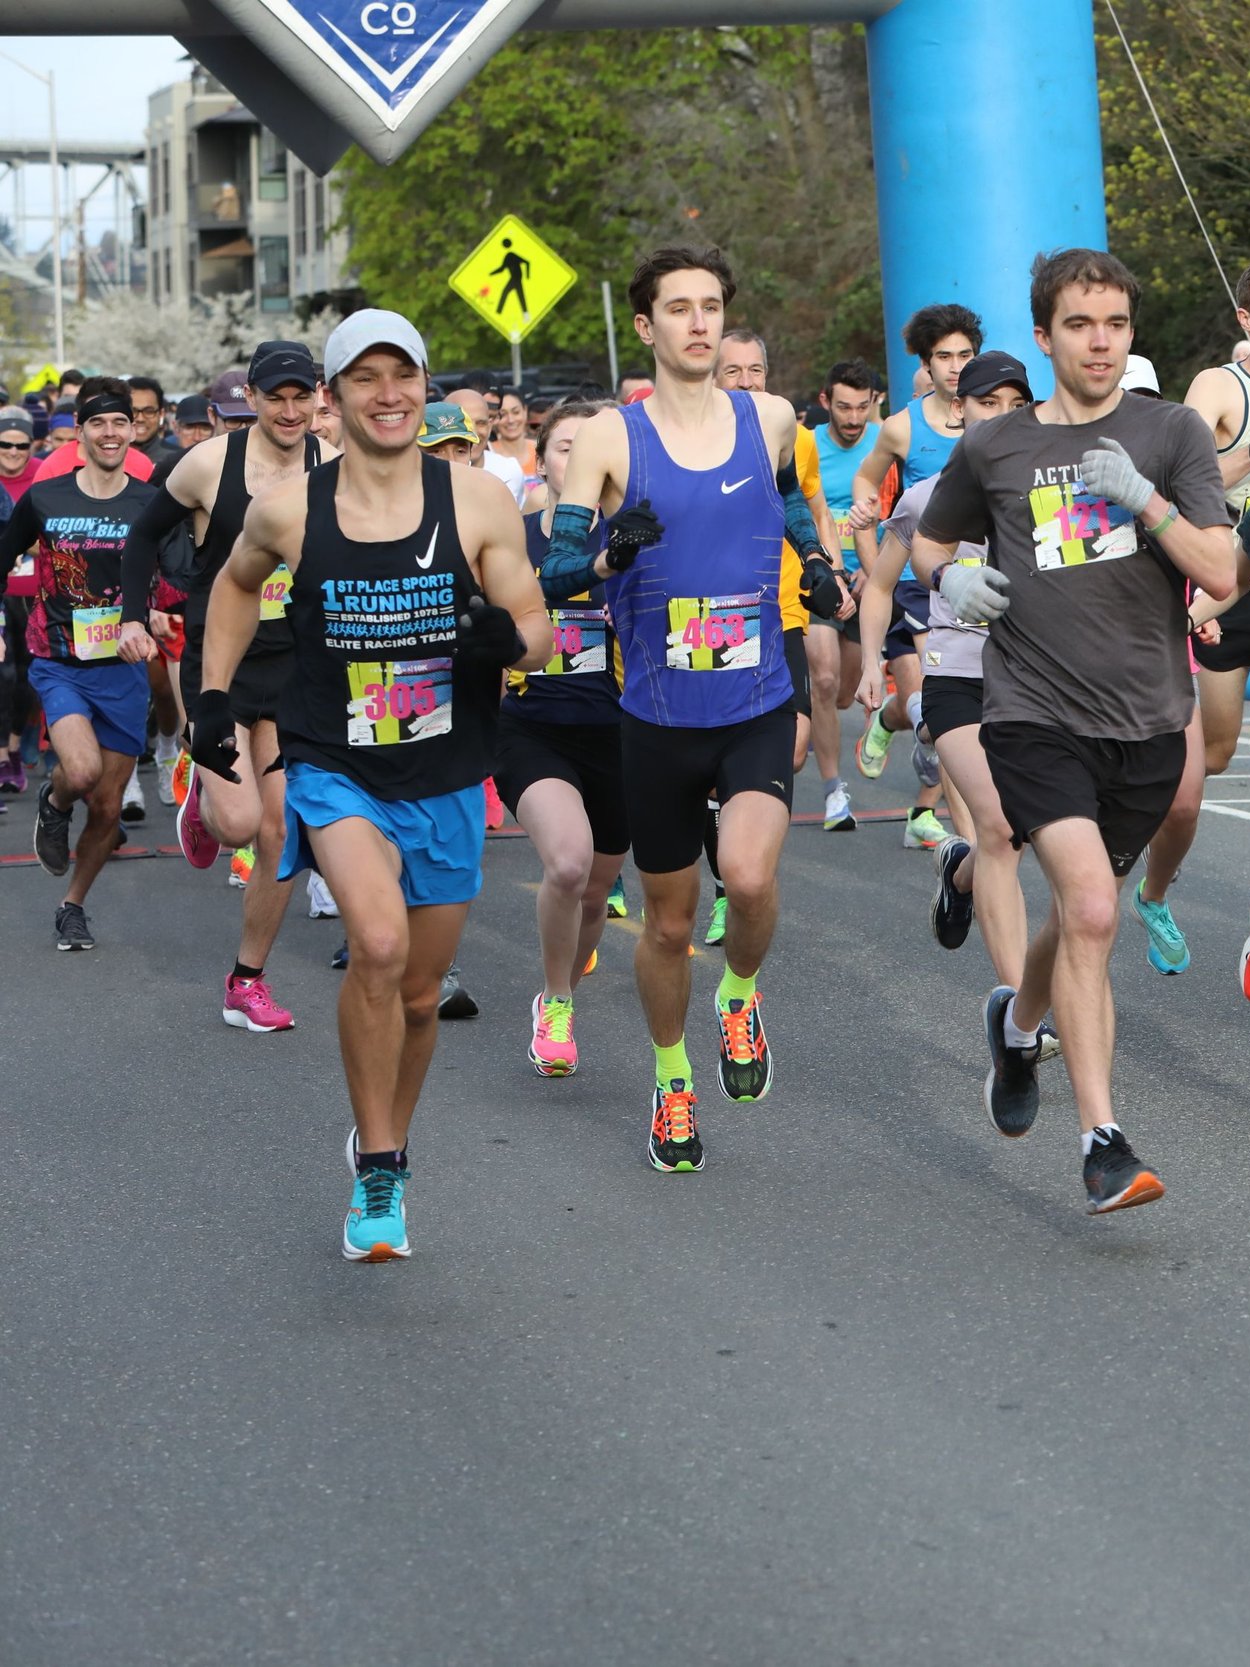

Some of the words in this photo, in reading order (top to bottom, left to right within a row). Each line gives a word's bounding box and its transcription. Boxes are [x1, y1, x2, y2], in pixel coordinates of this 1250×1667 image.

[1053, 498, 1110, 542] 121
[359, 579, 400, 593] PLACE
[402, 573, 454, 591] SPORTS
[344, 588, 454, 613] RUNNING
[340, 613, 411, 623] ESTABLISHED
[413, 608, 438, 619] 1978
[325, 638, 361, 650] ELITE
[365, 636, 417, 649] RACING
[422, 630, 456, 644] TEAM
[682, 614, 745, 650] 463
[364, 679, 437, 721] 305
